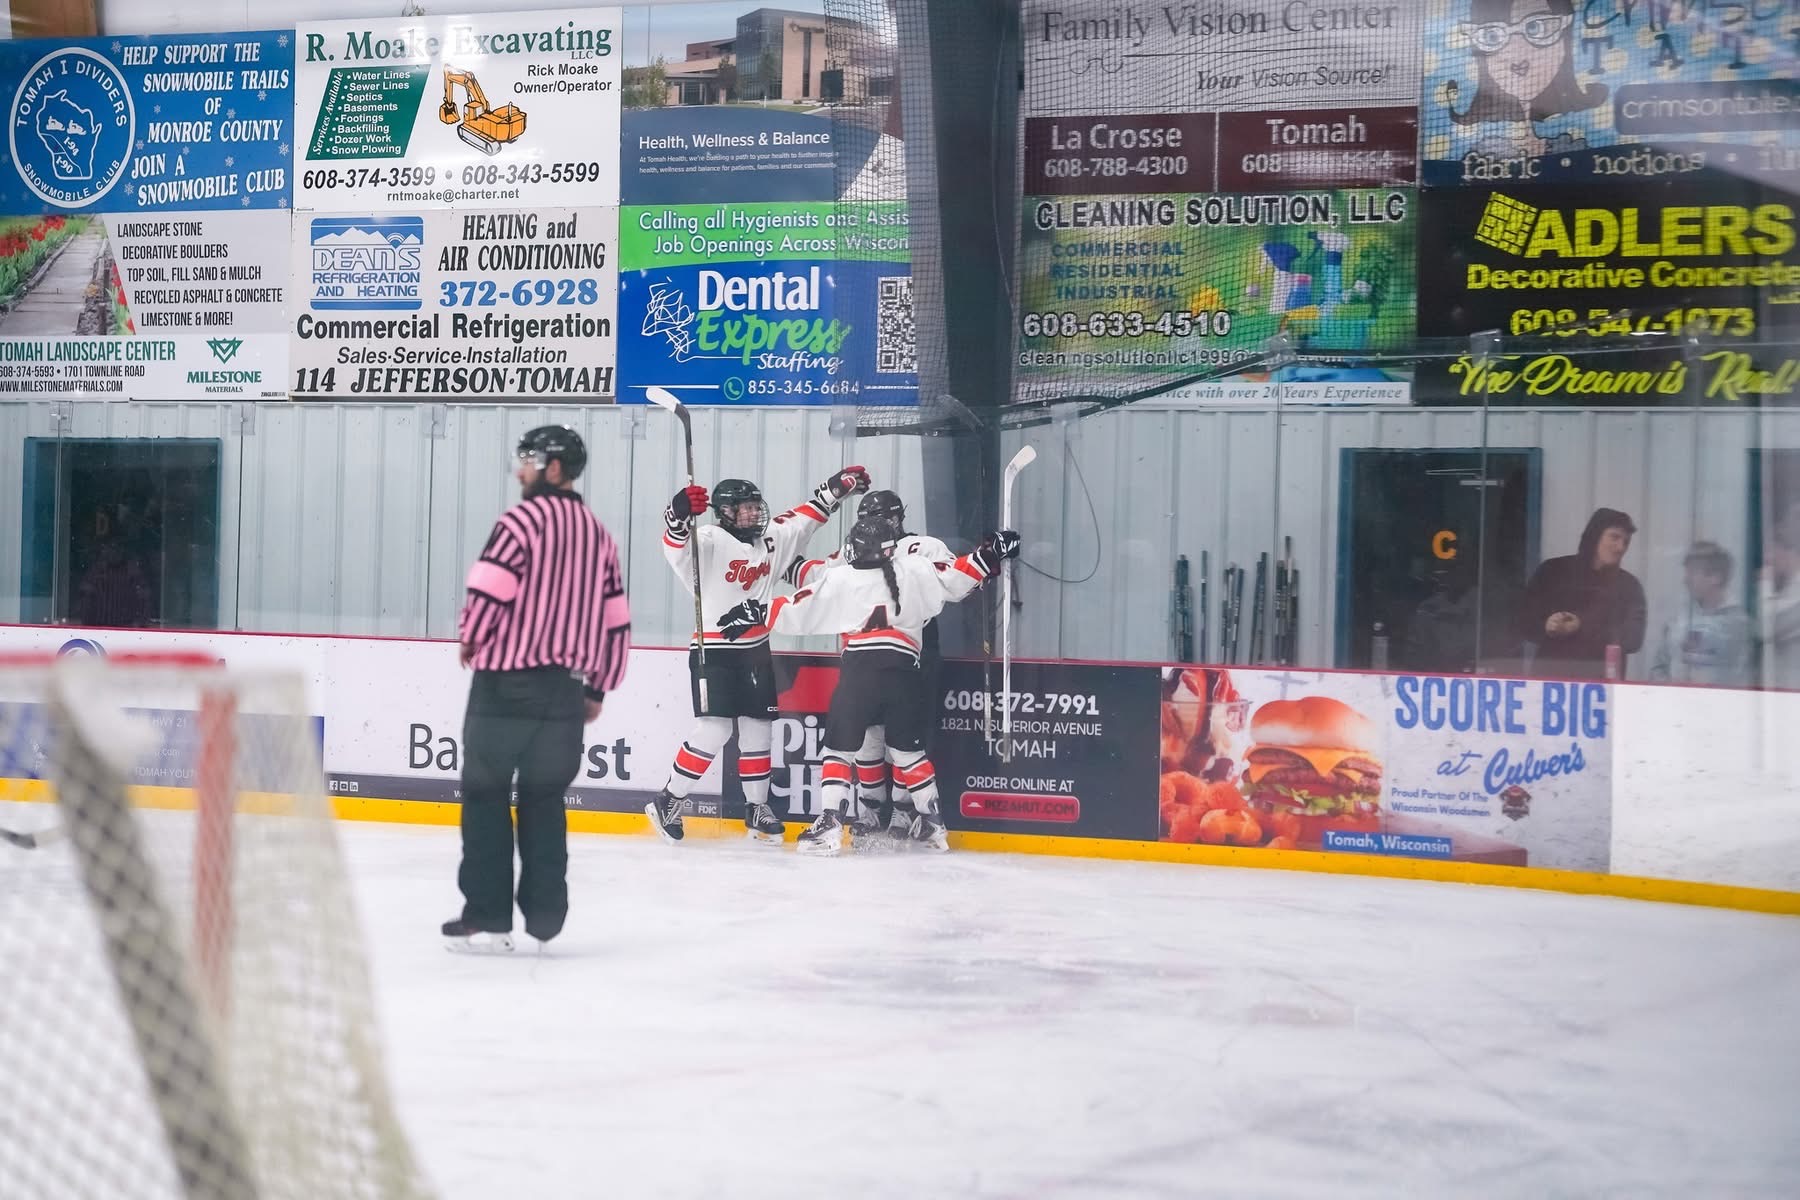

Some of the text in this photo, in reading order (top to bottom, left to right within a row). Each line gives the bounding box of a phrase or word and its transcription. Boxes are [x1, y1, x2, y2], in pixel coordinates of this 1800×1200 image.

[1043, 0, 1397, 47] Family Vision Center
[306, 21, 612, 62] R. Moake Excavating
[123, 43, 261, 65] HELP SUPPORT THE
[571, 50, 594, 60] LLC
[352, 70, 411, 81] Water Lines
[527, 63, 598, 76] Rick Moake
[143, 70, 289, 93] SNOWMOBILE TRAILS
[349, 81, 410, 91] Sewer Lines
[514, 81, 612, 94] Owner/Operator
[1197, 69, 1308, 91] Your Vision
[17, 60, 127, 127] TOMAH DIVIDERS
[346, 93, 383, 103] Septics
[205, 97, 222, 116] OF
[312, 71, 343, 155] Services Available
[343, 103, 398, 113] Basements
[337, 124, 390, 134] Backfilling
[340, 114, 384, 124] Footings
[147, 120, 283, 144] MONROE COUNTY
[334, 134, 392, 144] Dozer Work
[1051, 125, 1183, 151] La Crosse
[1266, 114, 1367, 145] Tomah
[63, 136, 80, 156] I-94
[331, 145, 402, 155] Snow Plowing
[639, 131, 830, 149] Health, Wellness & Balance
[55, 156, 74, 174] I-90
[131, 154, 185, 179] JOIN A
[660, 166, 684, 174] wellness
[1044, 155, 1189, 178] 608-788-4300
[1461, 147, 1705, 181] fabric notions
[24, 159, 120, 201] SNOWMOBILE CLUB
[302, 162, 600, 189] 608-374-3599 608-343-5599
[138, 168, 285, 207] SNOWMOBILE CLUB
[387, 189, 520, 202] rntmoake@charter.net
[639, 212, 698, 233] Calling
[705, 210, 725, 229] all
[732, 208, 818, 232] Hygienists
[1035, 193, 1406, 230] CLEANING SOLUTION, LLC
[117, 222, 203, 238] LANDSCAPE STONE
[462, 212, 577, 241] HEATING and
[1524, 204, 1795, 258] ADLERS
[122, 244, 228, 260] DECORATIVE BOULDERS
[653, 234, 836, 257] Job Openings Across
[1051, 242, 1184, 258] COMMERCIAL
[438, 243, 606, 271] AIR CONDITIONING
[127, 266, 262, 283] TOP SOIL, FILL SAND & MULCH
[312, 272, 421, 284] REFRIGERATION
[1052, 263, 1185, 279] RESIDENTIAL
[1467, 261, 1800, 289] Decorative Concrete
[134, 288, 283, 305] RECYCLED ASPHALT & CONCRETE
[316, 285, 418, 297] AND HEATING
[439, 279, 599, 307] 372-6928
[698, 266, 820, 312] Dental
[1056, 284, 1177, 300] INDUSTRIAL
[141, 311, 233, 327] LIMESTONE & MORE!
[297, 313, 611, 344] Commercial Refrigeration
[1023, 310, 1232, 338] 608-633-4510
[695, 309, 852, 366] Express
[0, 341, 176, 361] TOMAH LANDSCAPE CENTER
[0, 366, 145, 377] 608-374-5593 1701 TOWNLINE ROAD
[757, 353, 844, 375] Staffing
[187, 371, 262, 383] MILESTONE
[294, 367, 337, 393] 114
[1522, 354, 1687, 396] Dream is
[748, 381, 861, 395] 855-345-6684
[1195, 383, 1224, 399] with
[1229, 385, 1260, 399] over
[1283, 383, 1321, 399] Years
[1324, 383, 1403, 402] Experience
[1432, 530, 1457, 559] C
[1395, 676, 1607, 739] SCORE BIG
[941, 718, 1102, 736] 1821 AVENUE
[985, 739, 1057, 759] TOMAH
[1436, 742, 1586, 795] at Culver's
[966, 776, 1074, 792] ORDER ONLINE AT
[1391, 787, 1456, 800] Proud Partner
[698, 805, 717, 814] FDIC
[1391, 801, 1491, 817] Wisconsin Woodsmen
[1326, 832, 1450, 854] Tomah, Wisconsin
